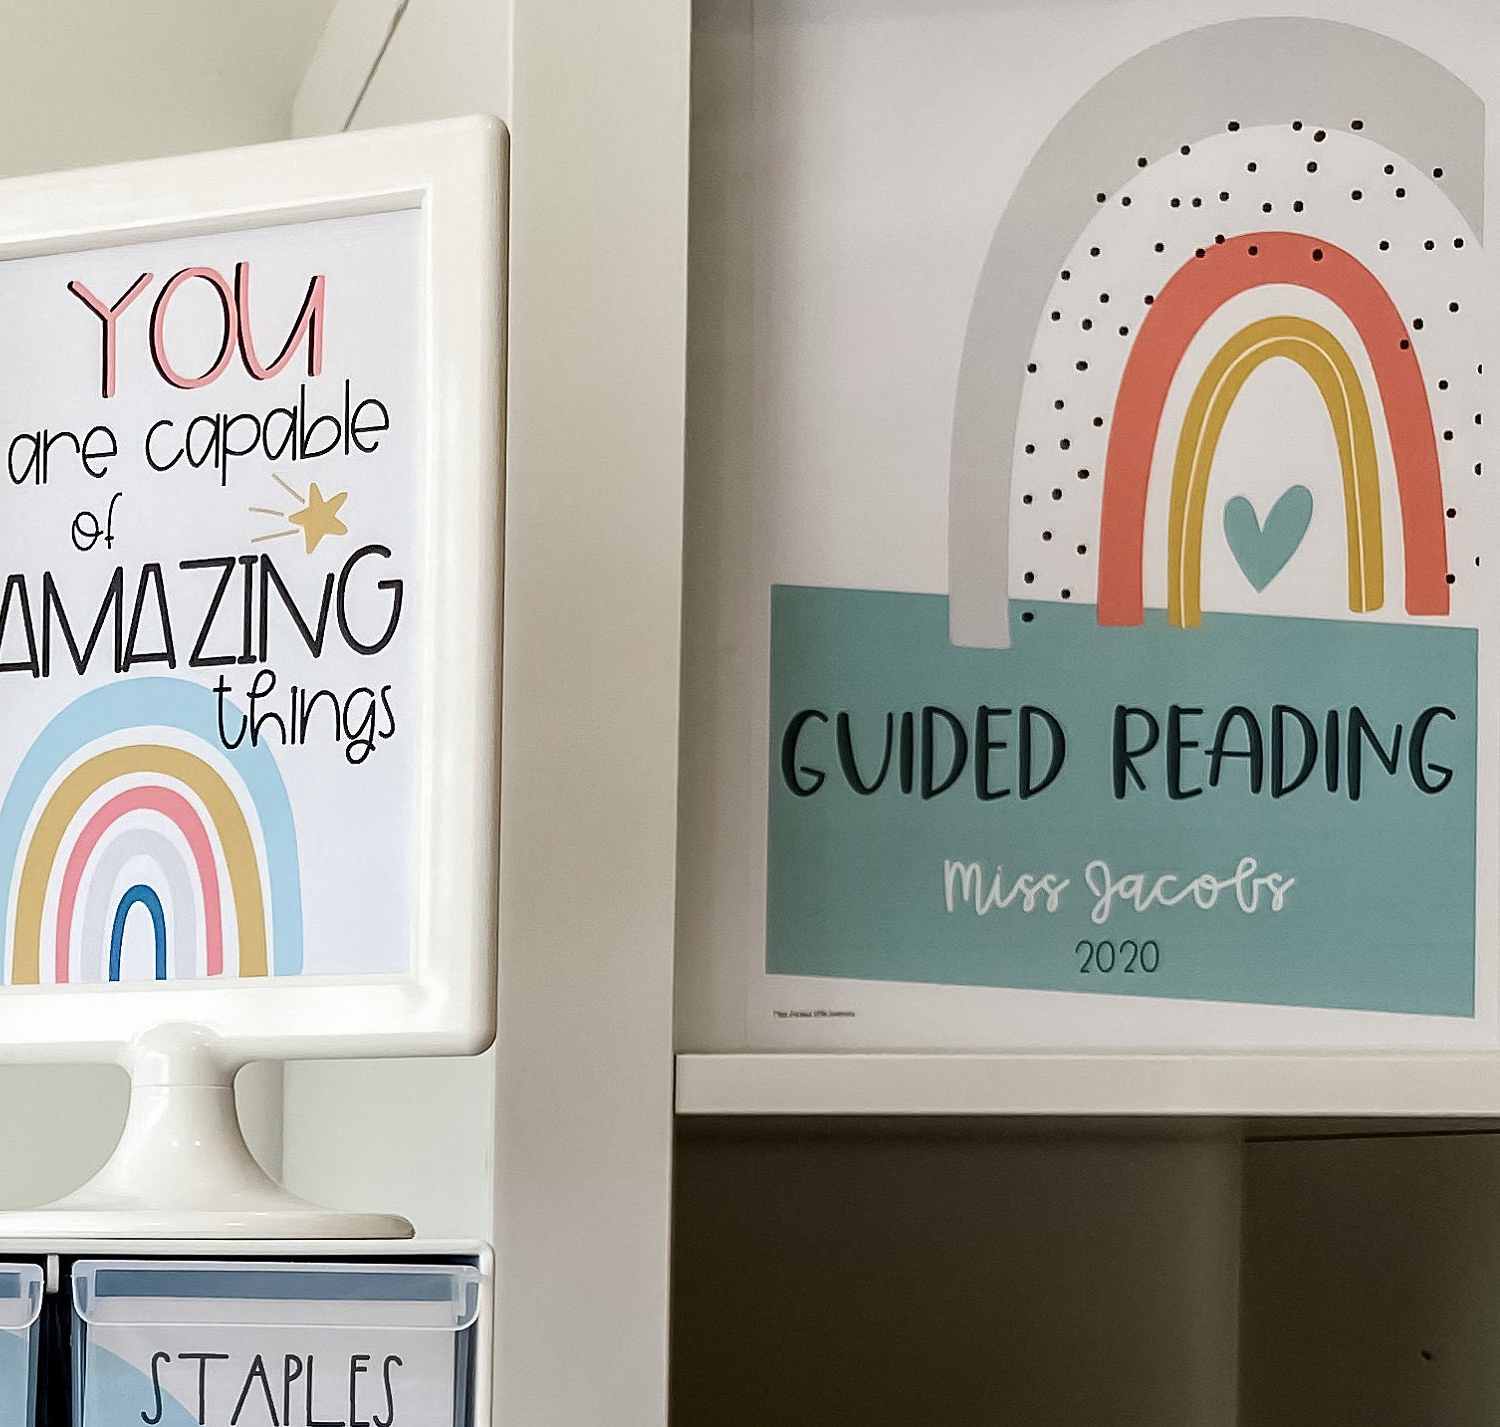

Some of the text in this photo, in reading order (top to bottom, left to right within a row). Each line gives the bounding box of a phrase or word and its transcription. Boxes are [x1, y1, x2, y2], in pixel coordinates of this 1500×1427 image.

[67, 260, 326, 398] YOU
[7, 379, 390, 487] are capable
[71, 492, 122, 551] of
[213, 669, 396, 765] things
[781, 704, 1457, 801] GUIDED READING
[943, 857, 1295, 924] Miss Jacobs
[1075, 939, 1160, 974] 2020
